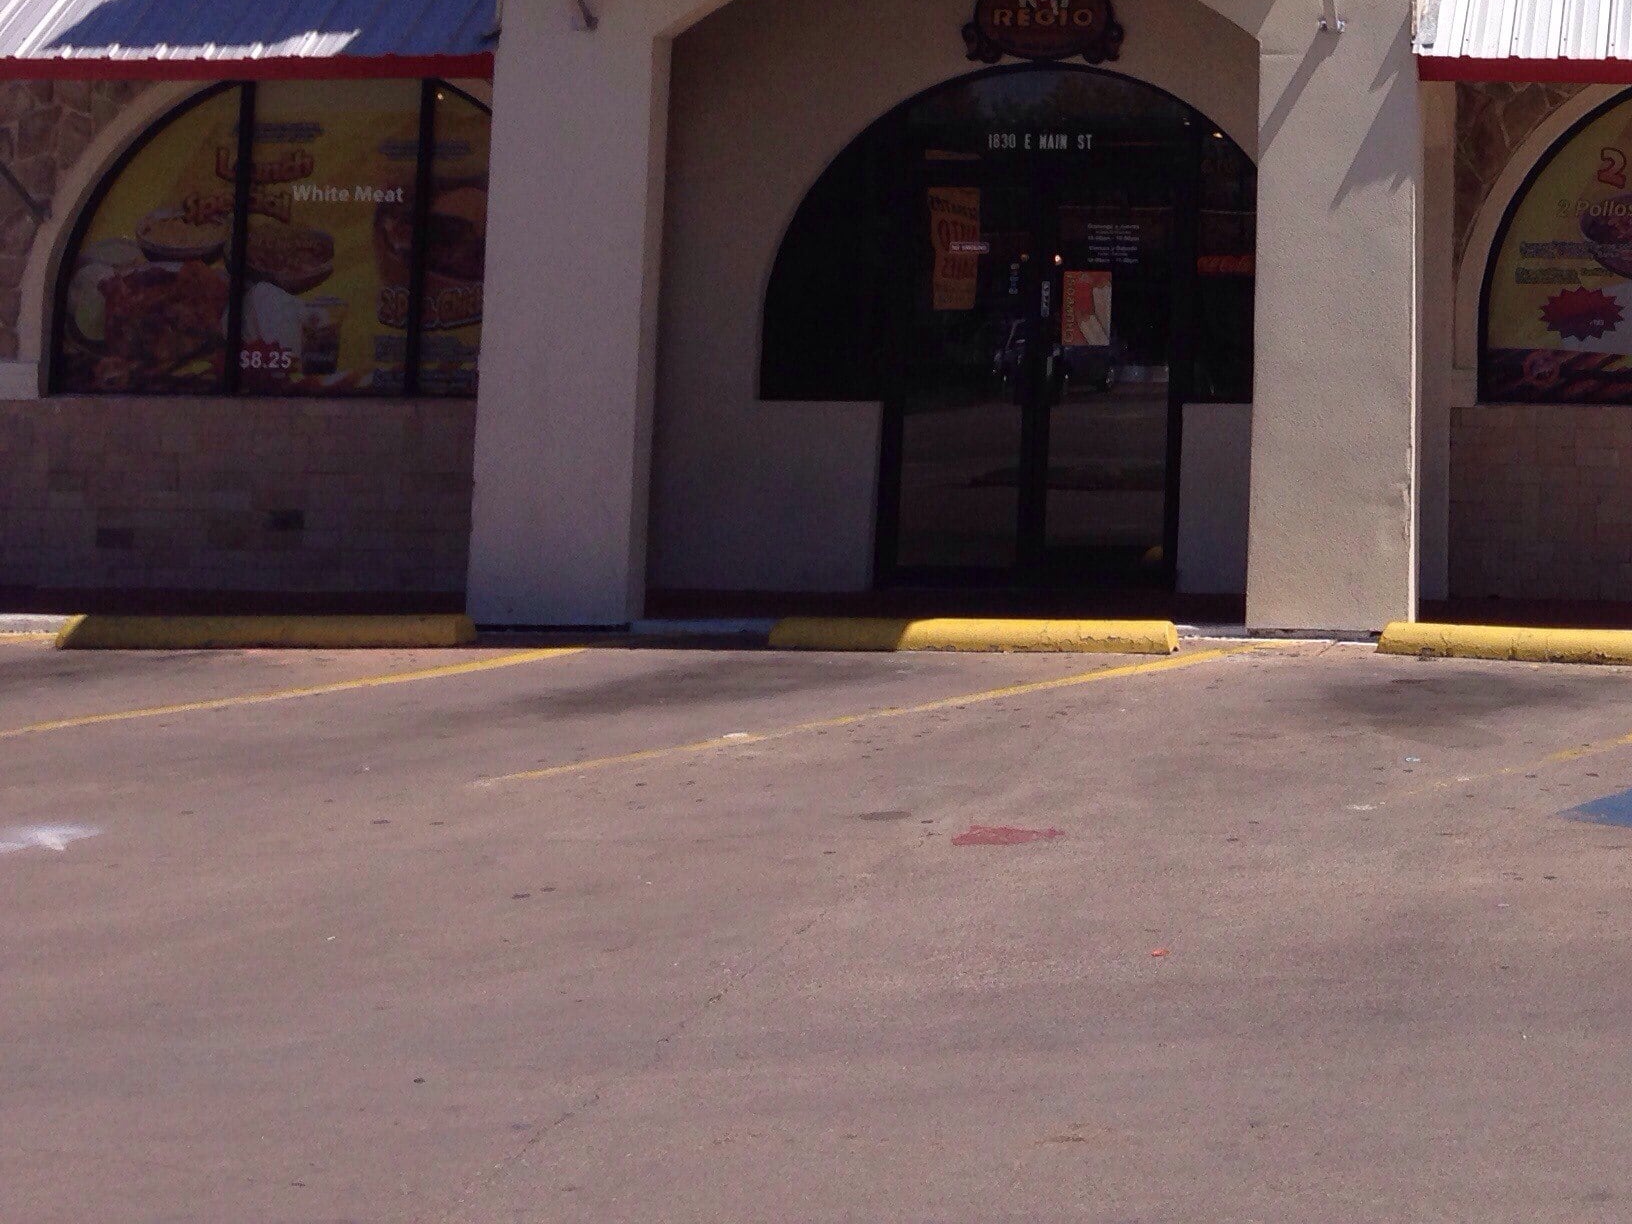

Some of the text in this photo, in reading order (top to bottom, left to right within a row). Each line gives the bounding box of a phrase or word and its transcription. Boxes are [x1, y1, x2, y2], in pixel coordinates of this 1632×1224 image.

[993, 8, 1093, 27] REGIO
[988, 134, 1093, 150] 1830 E MAIN ST
[1597, 147, 1627, 189] 2
[291, 184, 404, 203] White Meat
[1554, 199, 1572, 218] 2
[239, 350, 293, 369] $8.25
